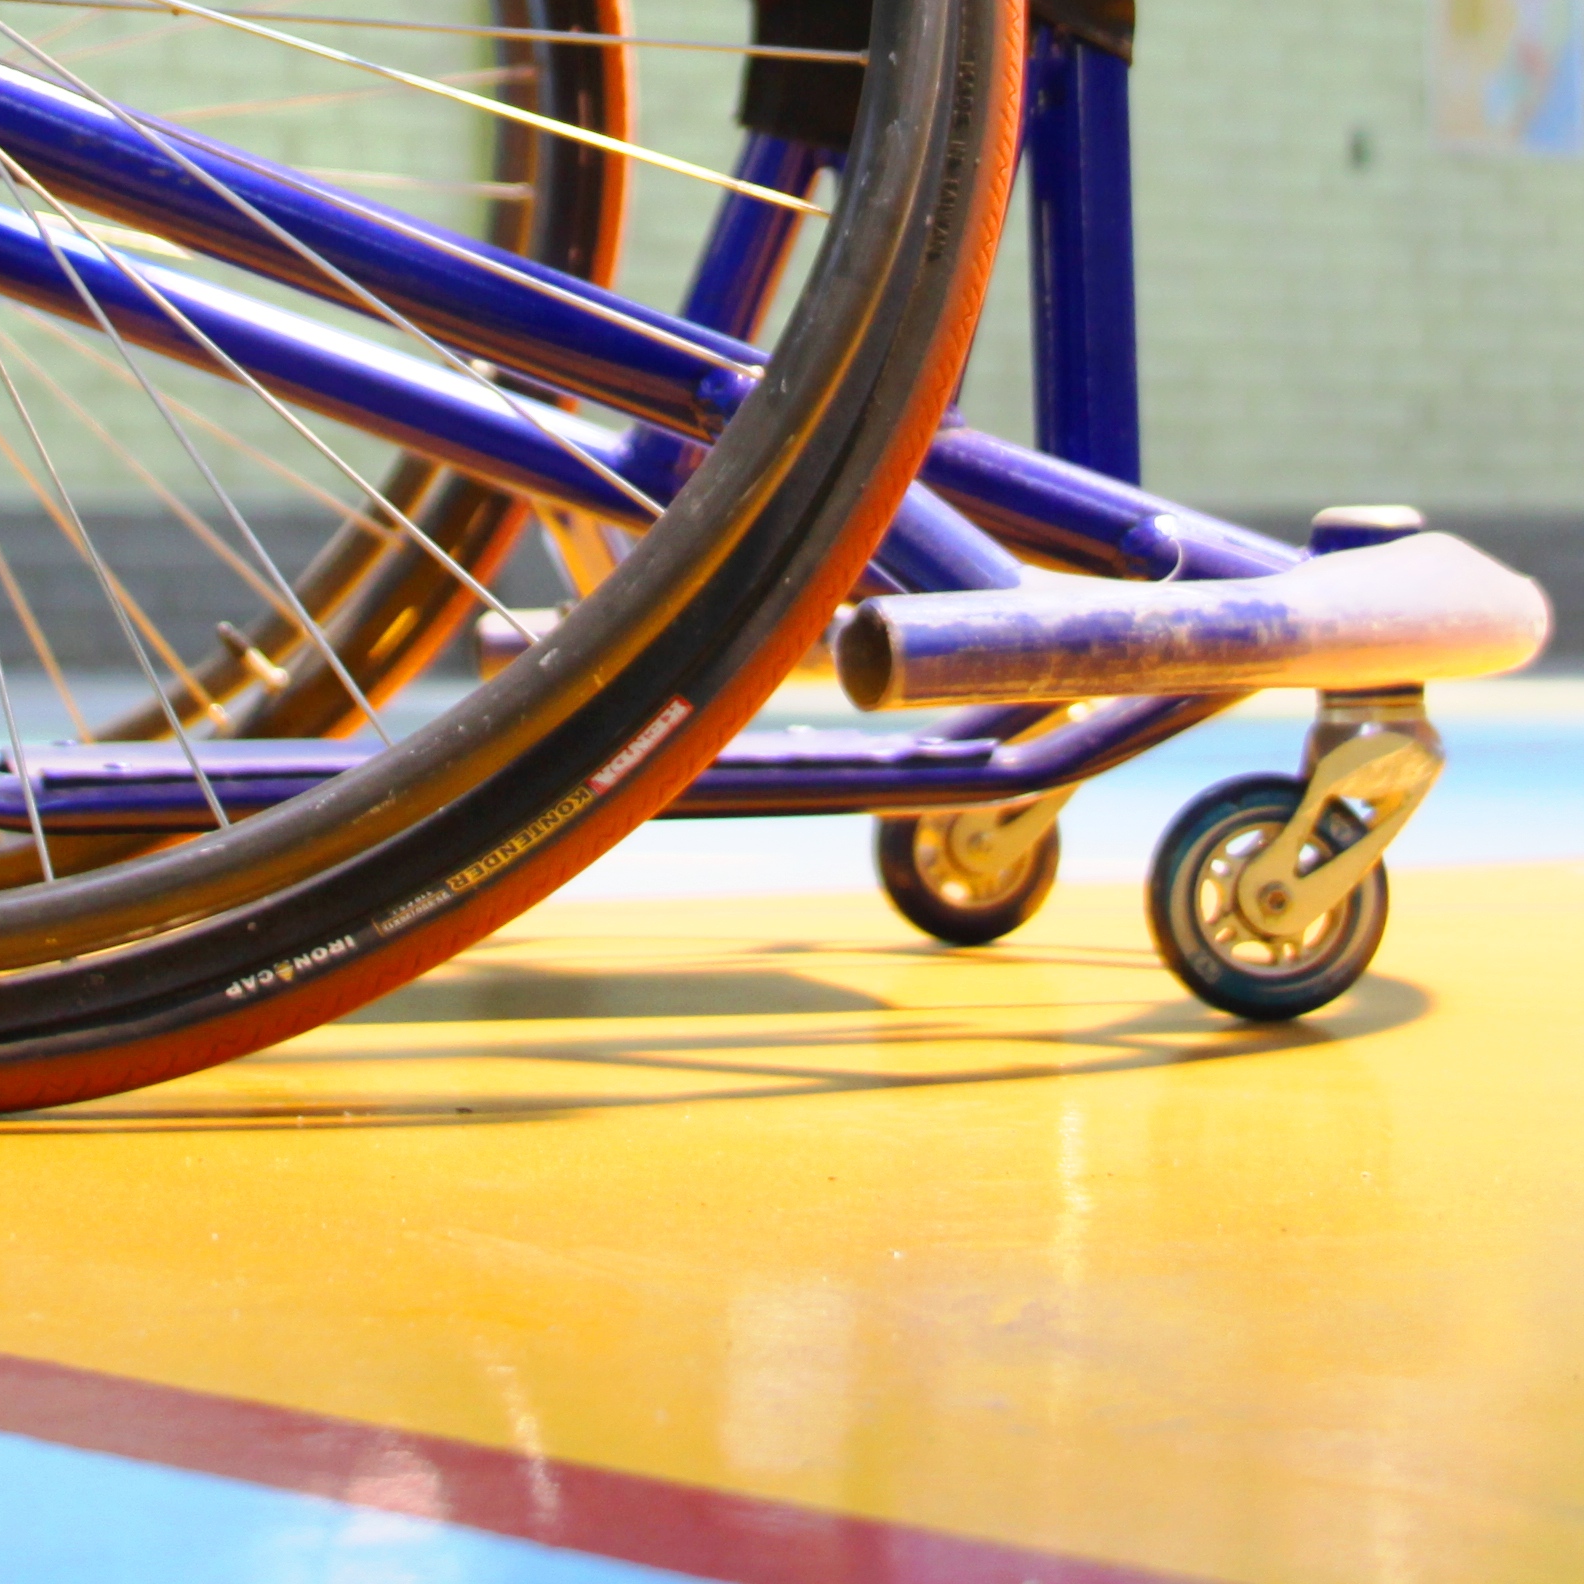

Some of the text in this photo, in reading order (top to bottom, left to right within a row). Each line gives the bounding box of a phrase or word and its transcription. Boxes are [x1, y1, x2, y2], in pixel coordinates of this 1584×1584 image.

[448, 699, 688, 891] KENDA KONTENDER
[225, 934, 356, 999] IRON CAP
